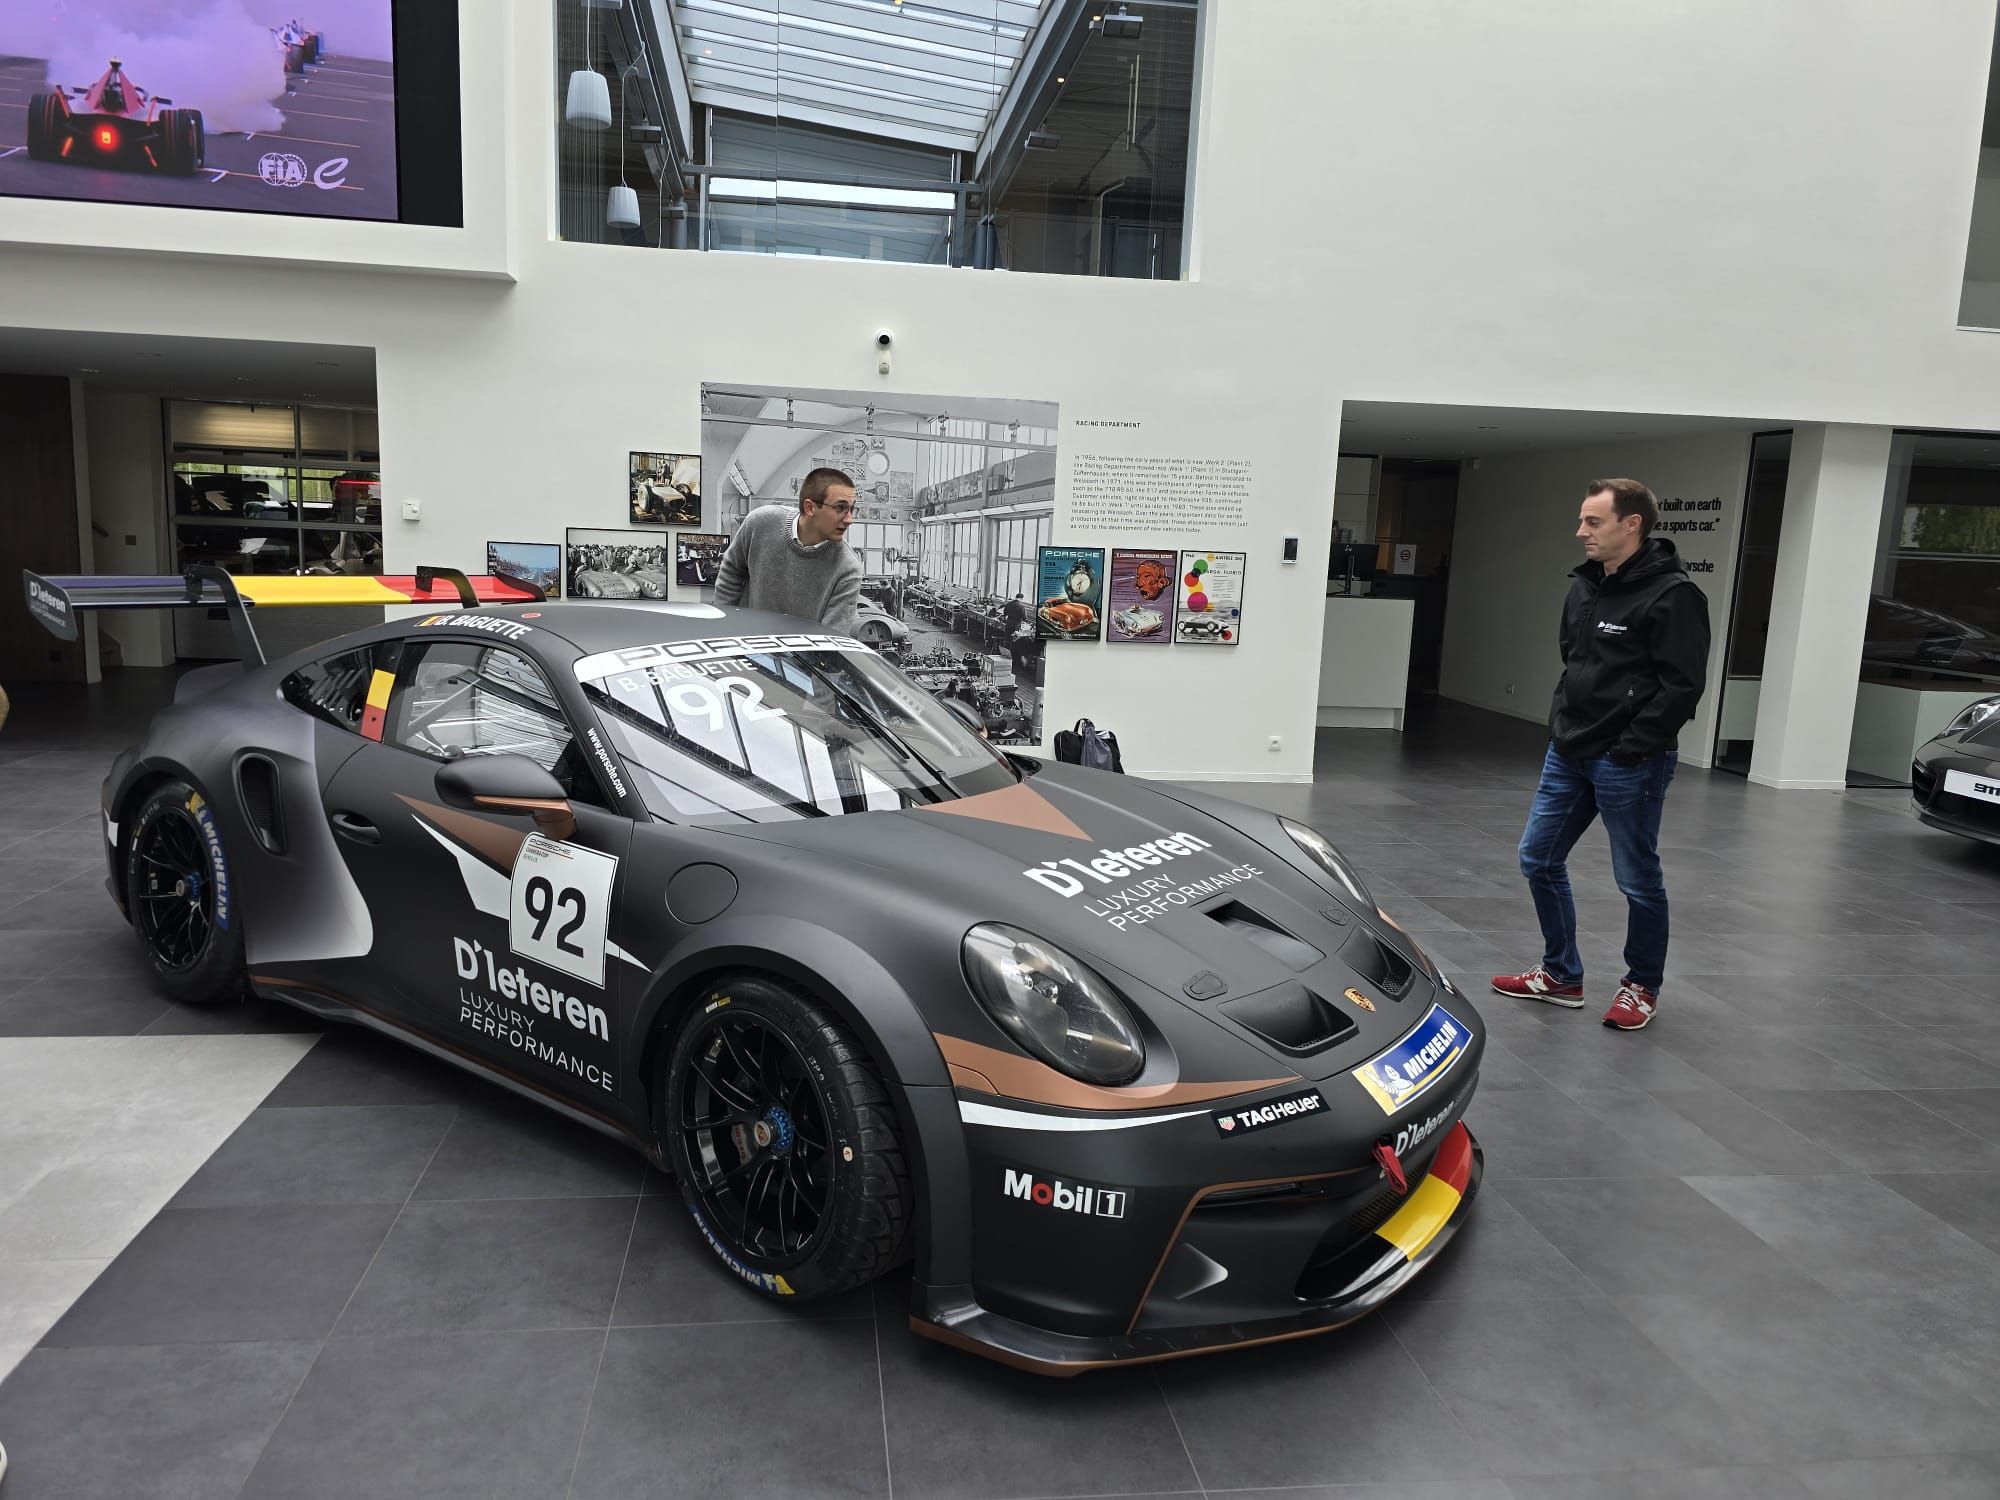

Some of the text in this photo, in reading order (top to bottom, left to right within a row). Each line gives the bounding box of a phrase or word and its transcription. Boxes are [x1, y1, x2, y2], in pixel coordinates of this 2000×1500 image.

[1663, 522, 1668, 531] a
[1669, 520, 1697, 534] sports
[1664, 498, 1684, 511] built
[1684, 501, 1696, 511] on
[1697, 497, 1722, 511] earth
[434, 615, 534, 640] B. BAGUETTE
[614, 635, 866, 666] PORSCHE
[617, 658, 758, 692] B. BAGUETTE
[666, 676, 788, 732] 92
[587, 727, 627, 798] www.porsche.com
[530, 838, 571, 854] PORSCHE
[203, 822, 227, 920] MICHELIN
[525, 876, 586, 958] 92
[1084, 873, 1178, 918] LUXURY
[1107, 863, 1264, 932] PERFORMANCE
[460, 987, 535, 1032] LUXURY
[460, 1007, 613, 1092] PERFORMANCE
[1403, 1020, 1458, 1080] MICHELIN
[1003, 1168, 1093, 1214] Mobil
[693, 1212, 761, 1286] MICHELIN
